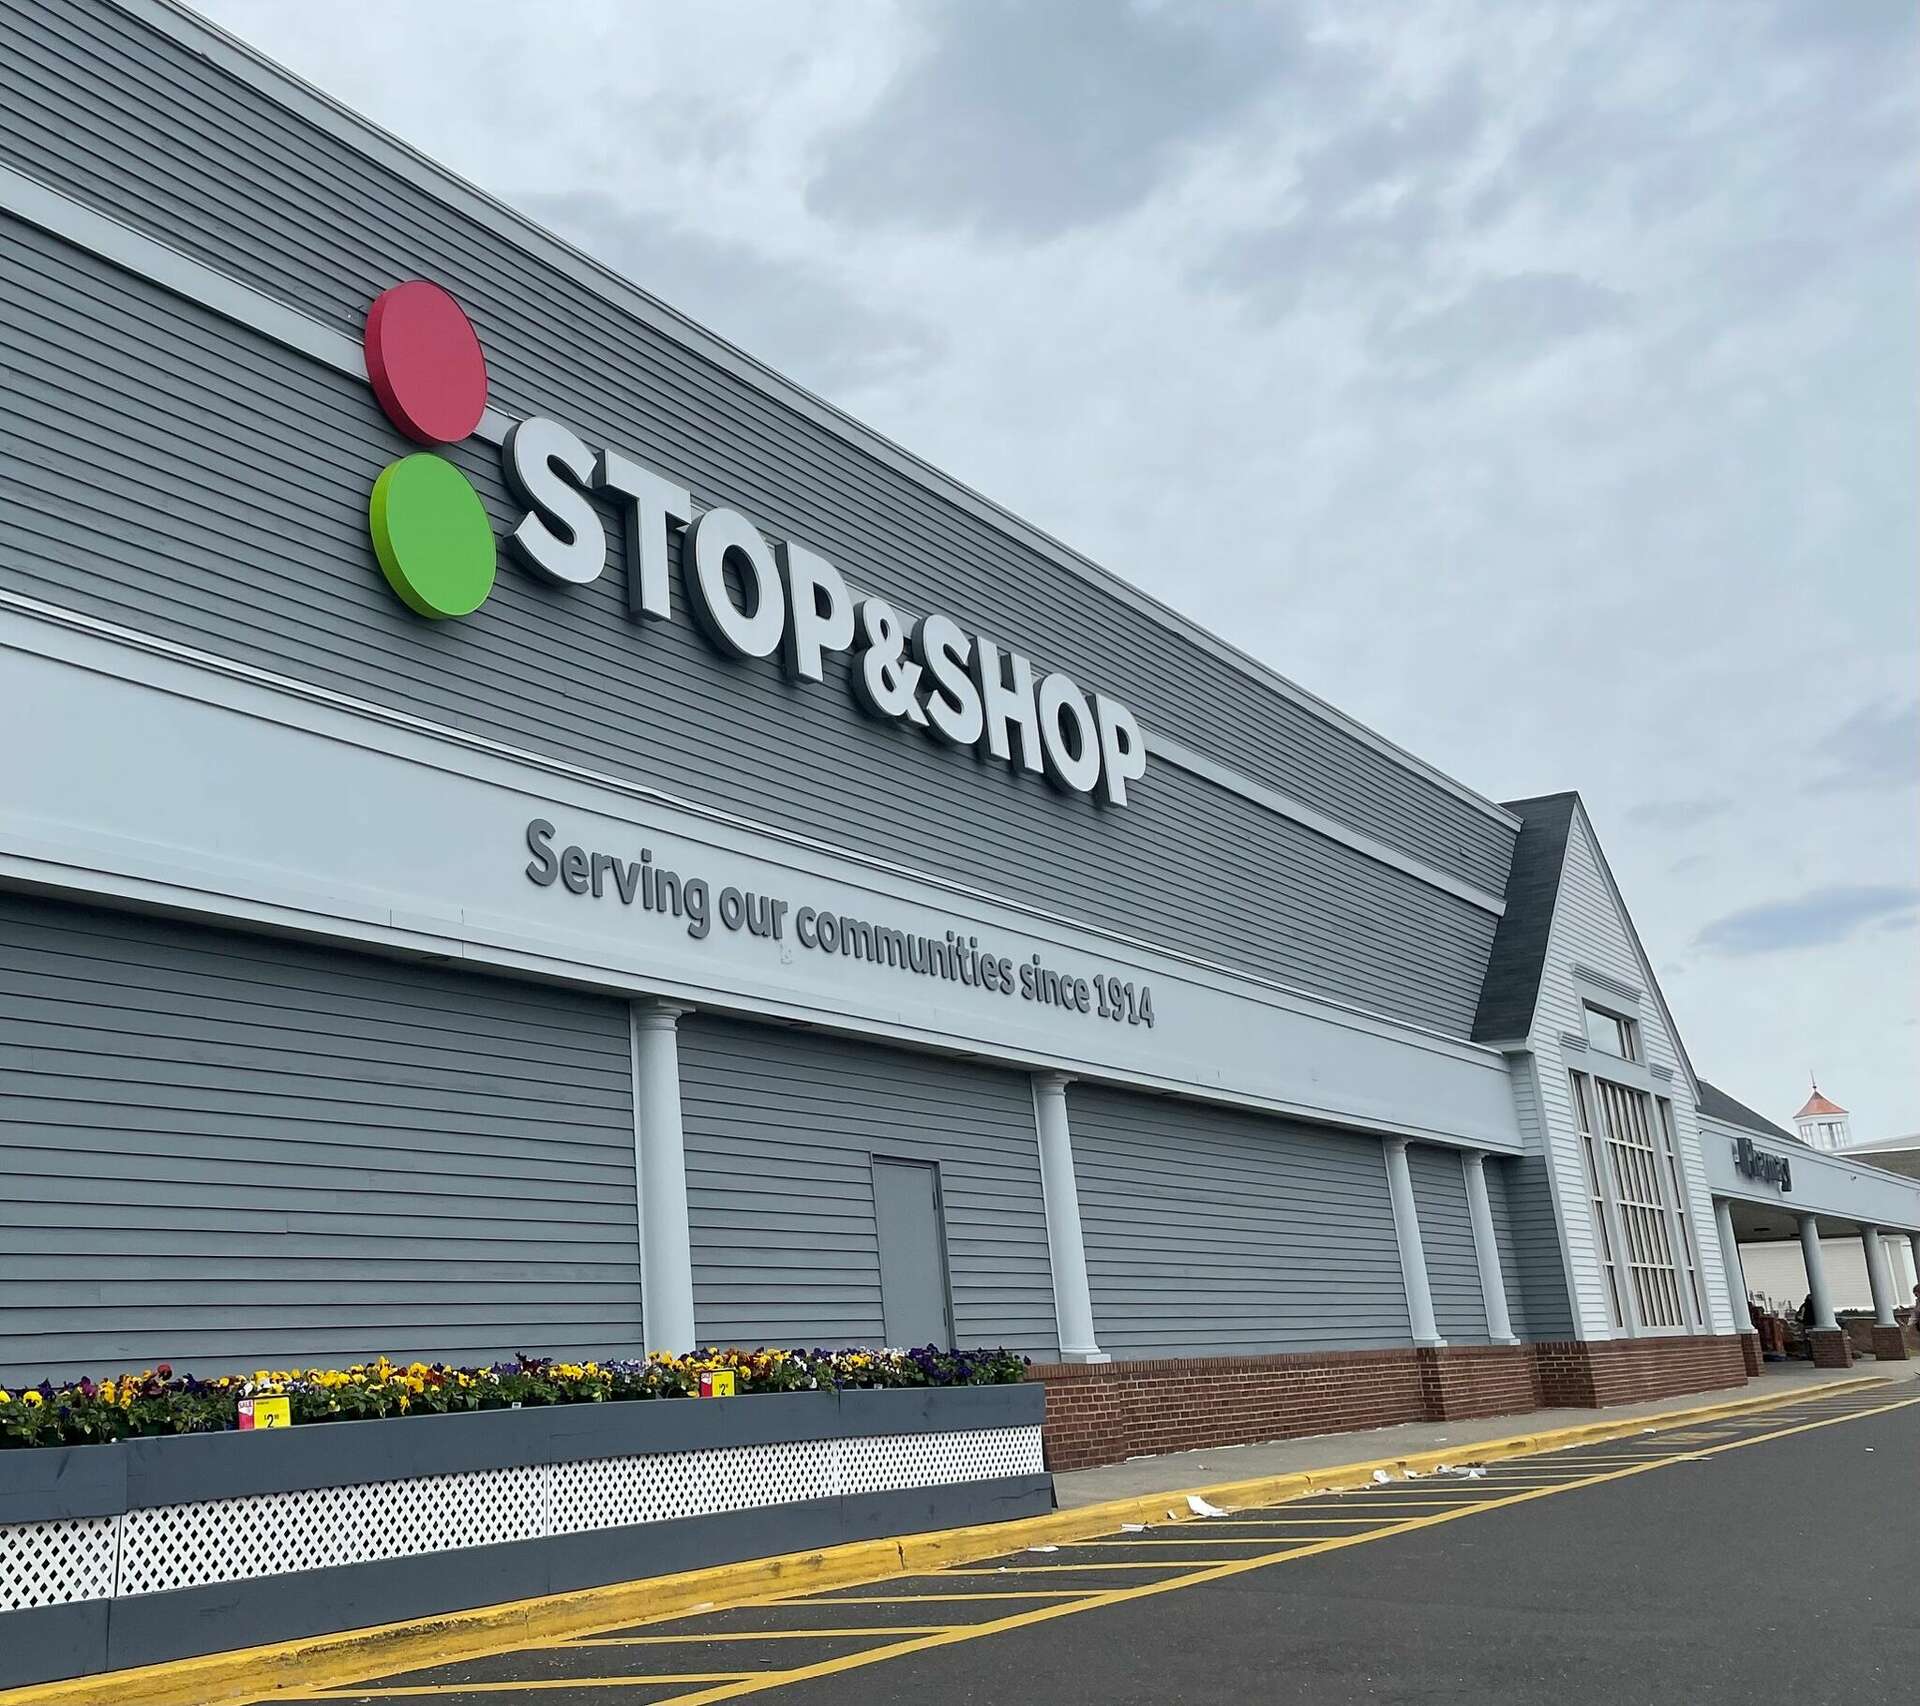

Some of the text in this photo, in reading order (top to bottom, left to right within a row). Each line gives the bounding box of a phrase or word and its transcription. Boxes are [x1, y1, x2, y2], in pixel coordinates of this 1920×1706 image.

[503, 416, 1146, 807] STOP&SHOP
[526, 818, 1155, 1028] Serving our communities since 1914
